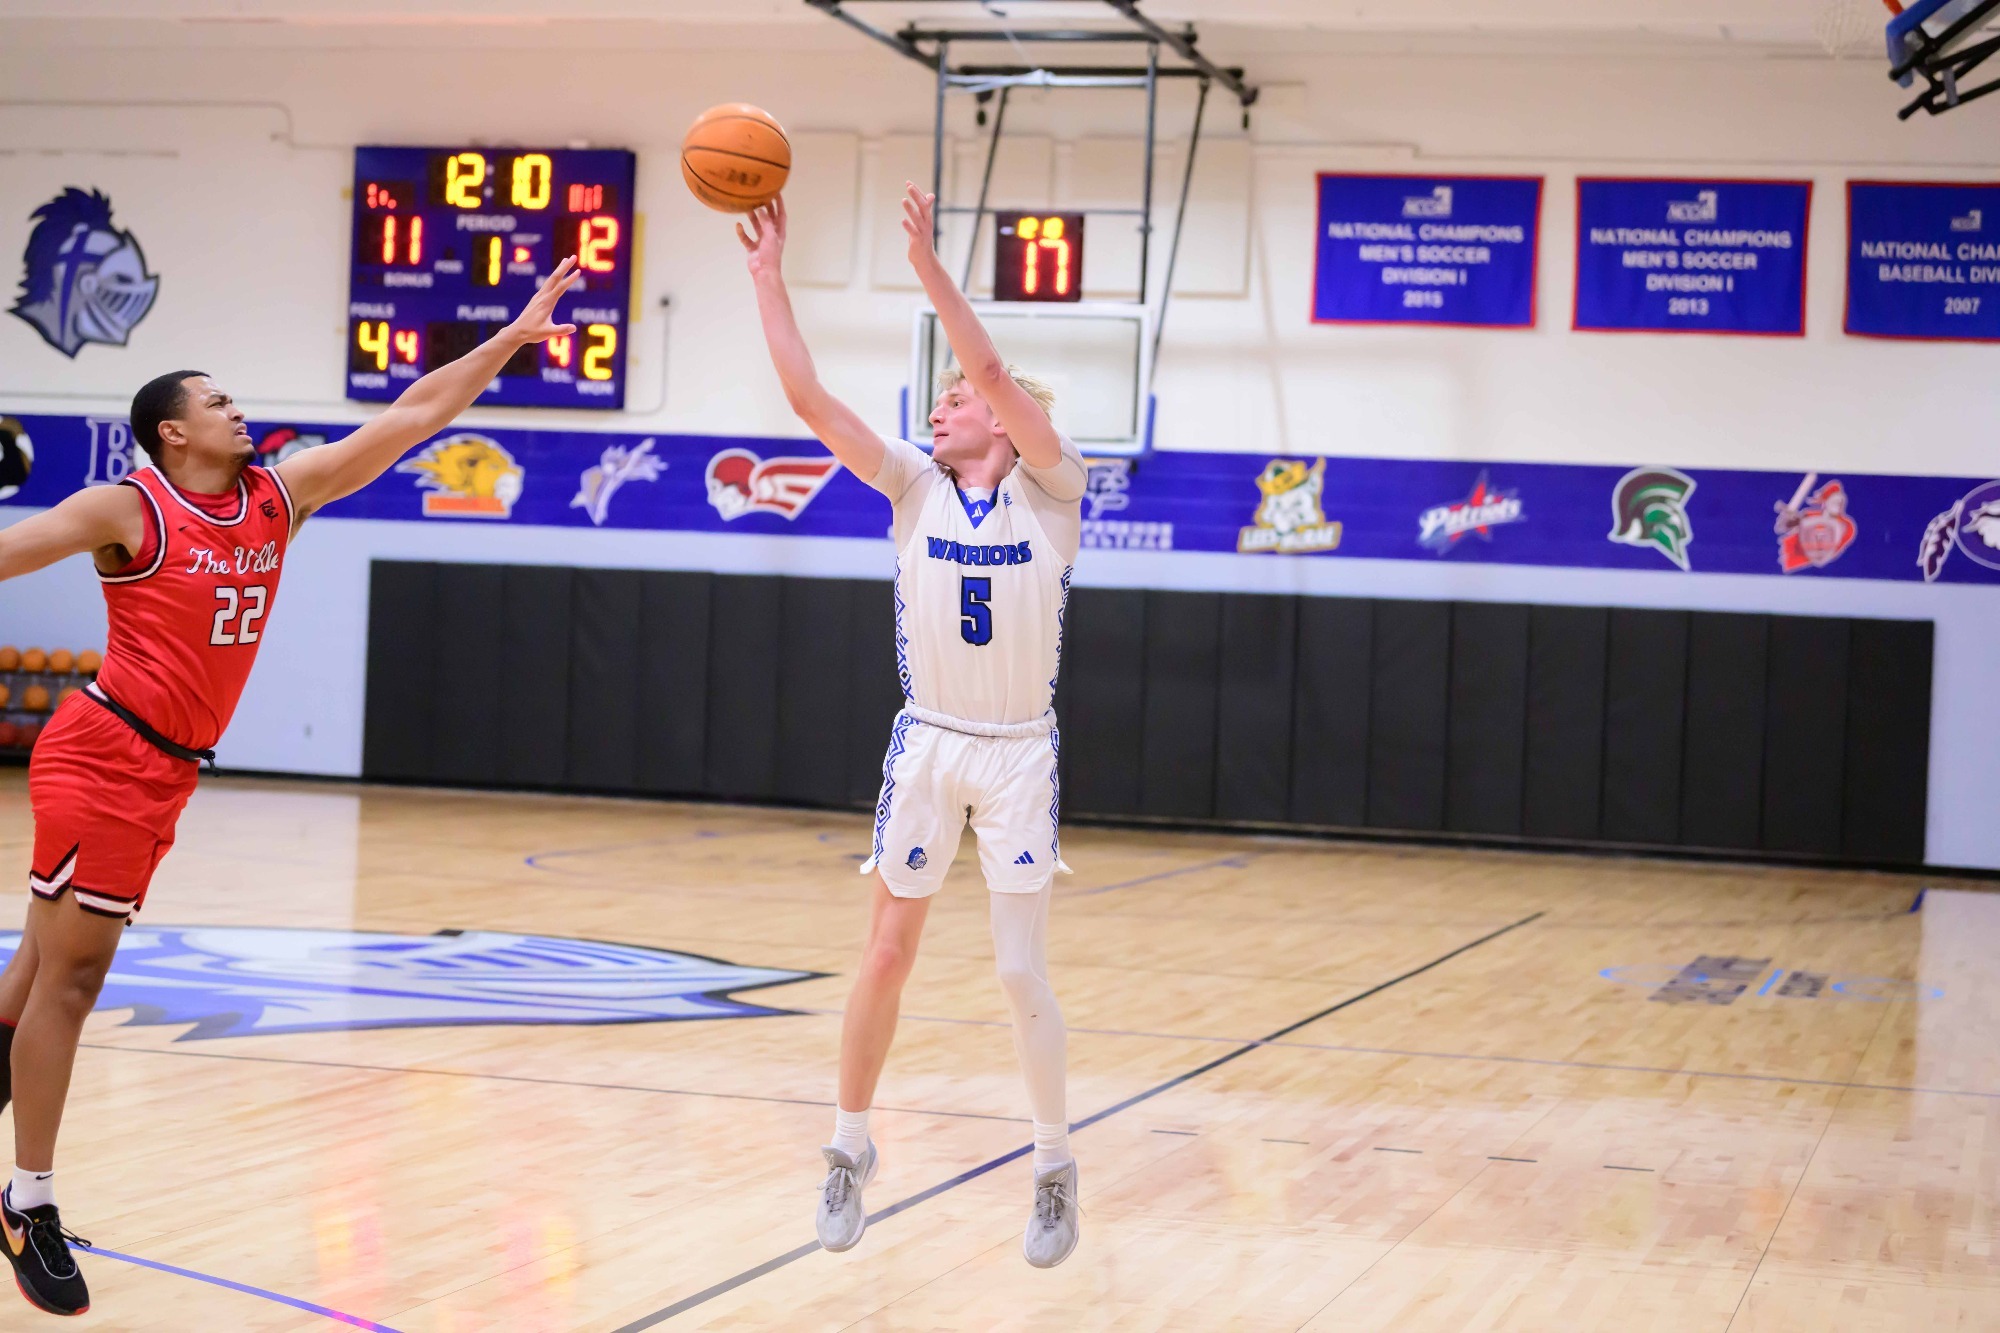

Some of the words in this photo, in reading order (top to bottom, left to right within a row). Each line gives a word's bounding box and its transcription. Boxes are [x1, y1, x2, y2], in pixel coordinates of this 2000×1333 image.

[456, 214, 517, 231] PERIOD
[1328, 222, 1415, 241] NATIONAL
[1419, 223, 1524, 243] CHAMPIONS
[383, 215, 423, 265] 11
[578, 216, 619, 272] 12
[1590, 228, 1680, 246] NATIONAL
[1684, 229, 1792, 248] CHAMPIONS
[1861, 241, 1951, 261] NATIONAL
[1957, 243, 2000, 261] CHA
[488, 236, 502, 286] 1
[1025, 238, 1069, 294] 17
[1622, 251, 1679, 268] MEN'S
[1682, 251, 1757, 270] SOCCER
[1878, 263, 1965, 283] BASEBALL
[1646, 274, 1723, 292] DIVISION
[1944, 297, 1981, 315] 2007
[358, 321, 390, 370] 4
[395, 330, 419, 363] 4
[547, 335, 572, 367] 4
[583, 323, 617, 380] 2
[186, 547, 231, 575] The
[927, 536, 1033, 565] WARRIORS
[209, 585, 268, 646] 22
[960, 574, 993, 646] 5
